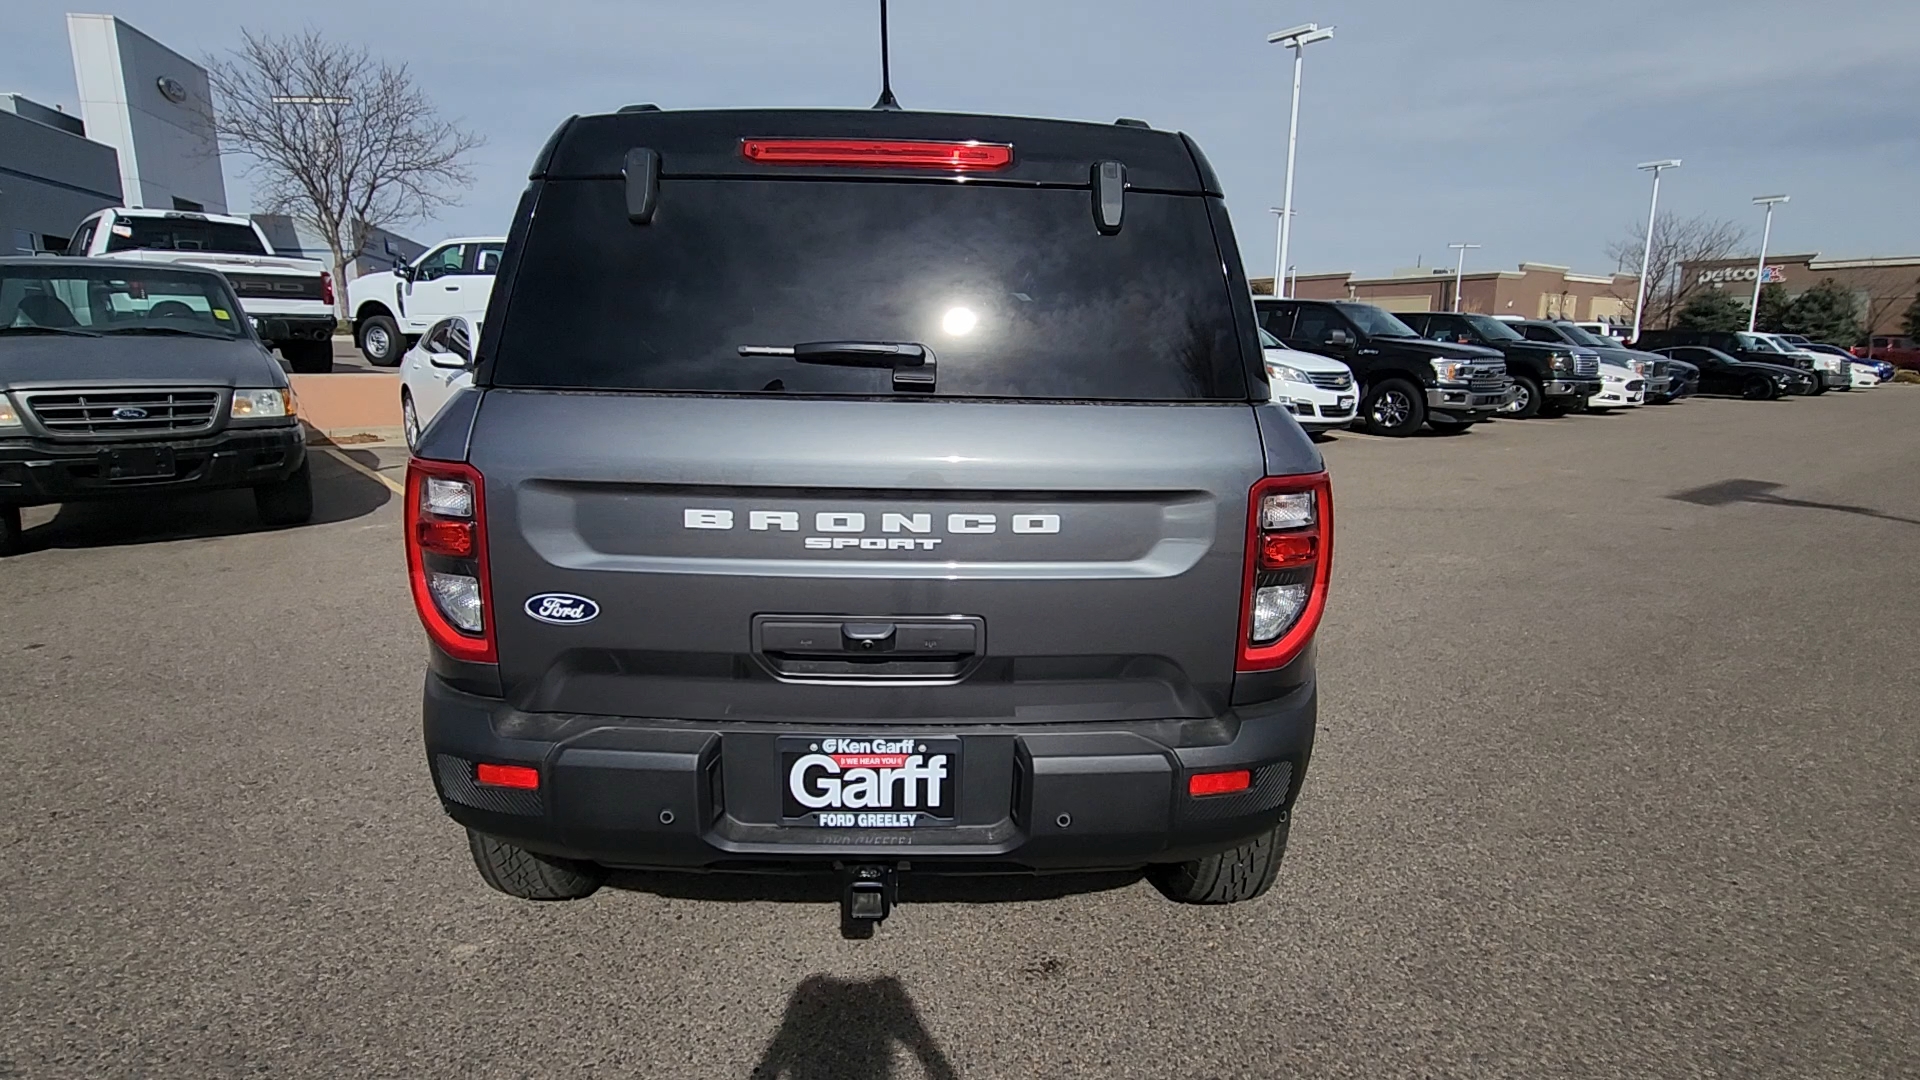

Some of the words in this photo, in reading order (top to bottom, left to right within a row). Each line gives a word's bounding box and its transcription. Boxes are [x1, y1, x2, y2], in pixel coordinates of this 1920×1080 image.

[684, 509, 1061, 534] BRONCO
[804, 537, 942, 550] SPORT
[538, 597, 585, 618] Ford
[838, 739, 870, 753] Ken
[872, 739, 914, 754] Garff
[846, 757, 859, 765] WE
[859, 757, 881, 765] HEAR
[881, 757, 897, 765] YOU
[789, 754, 947, 808] Garff
[819, 814, 855, 827] FORD
[857, 814, 917, 827] GREELEY
